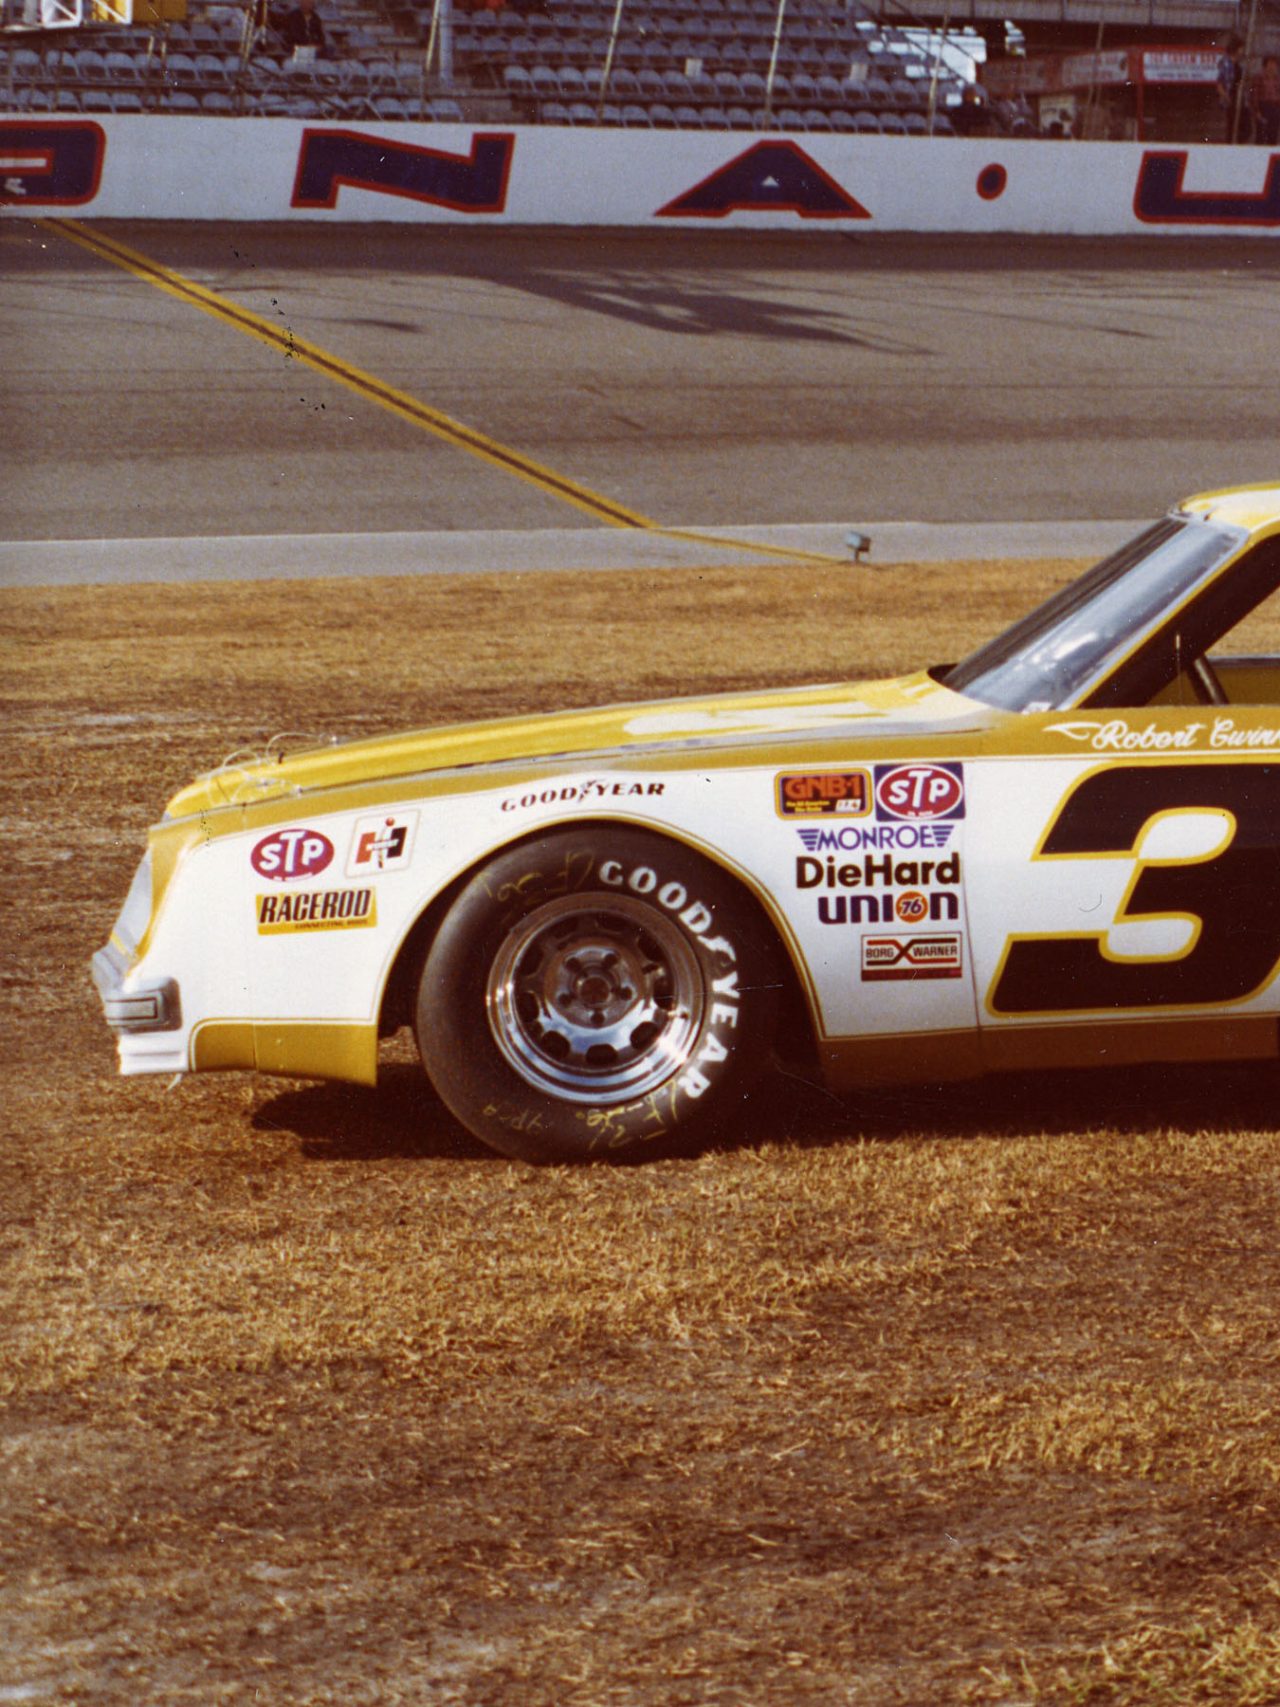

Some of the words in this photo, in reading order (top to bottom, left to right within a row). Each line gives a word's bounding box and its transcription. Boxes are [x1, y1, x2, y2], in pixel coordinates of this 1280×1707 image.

[1091, 720, 1206, 749] Robert
[888, 770, 950, 808] STP
[259, 831, 324, 873] STP
[817, 825, 934, 850] MONROE
[796, 852, 960, 888] DieHard
[260, 889, 371, 924] RACEROD
[866, 948, 894, 959] BORG
[913, 944, 958, 956] WARNER
